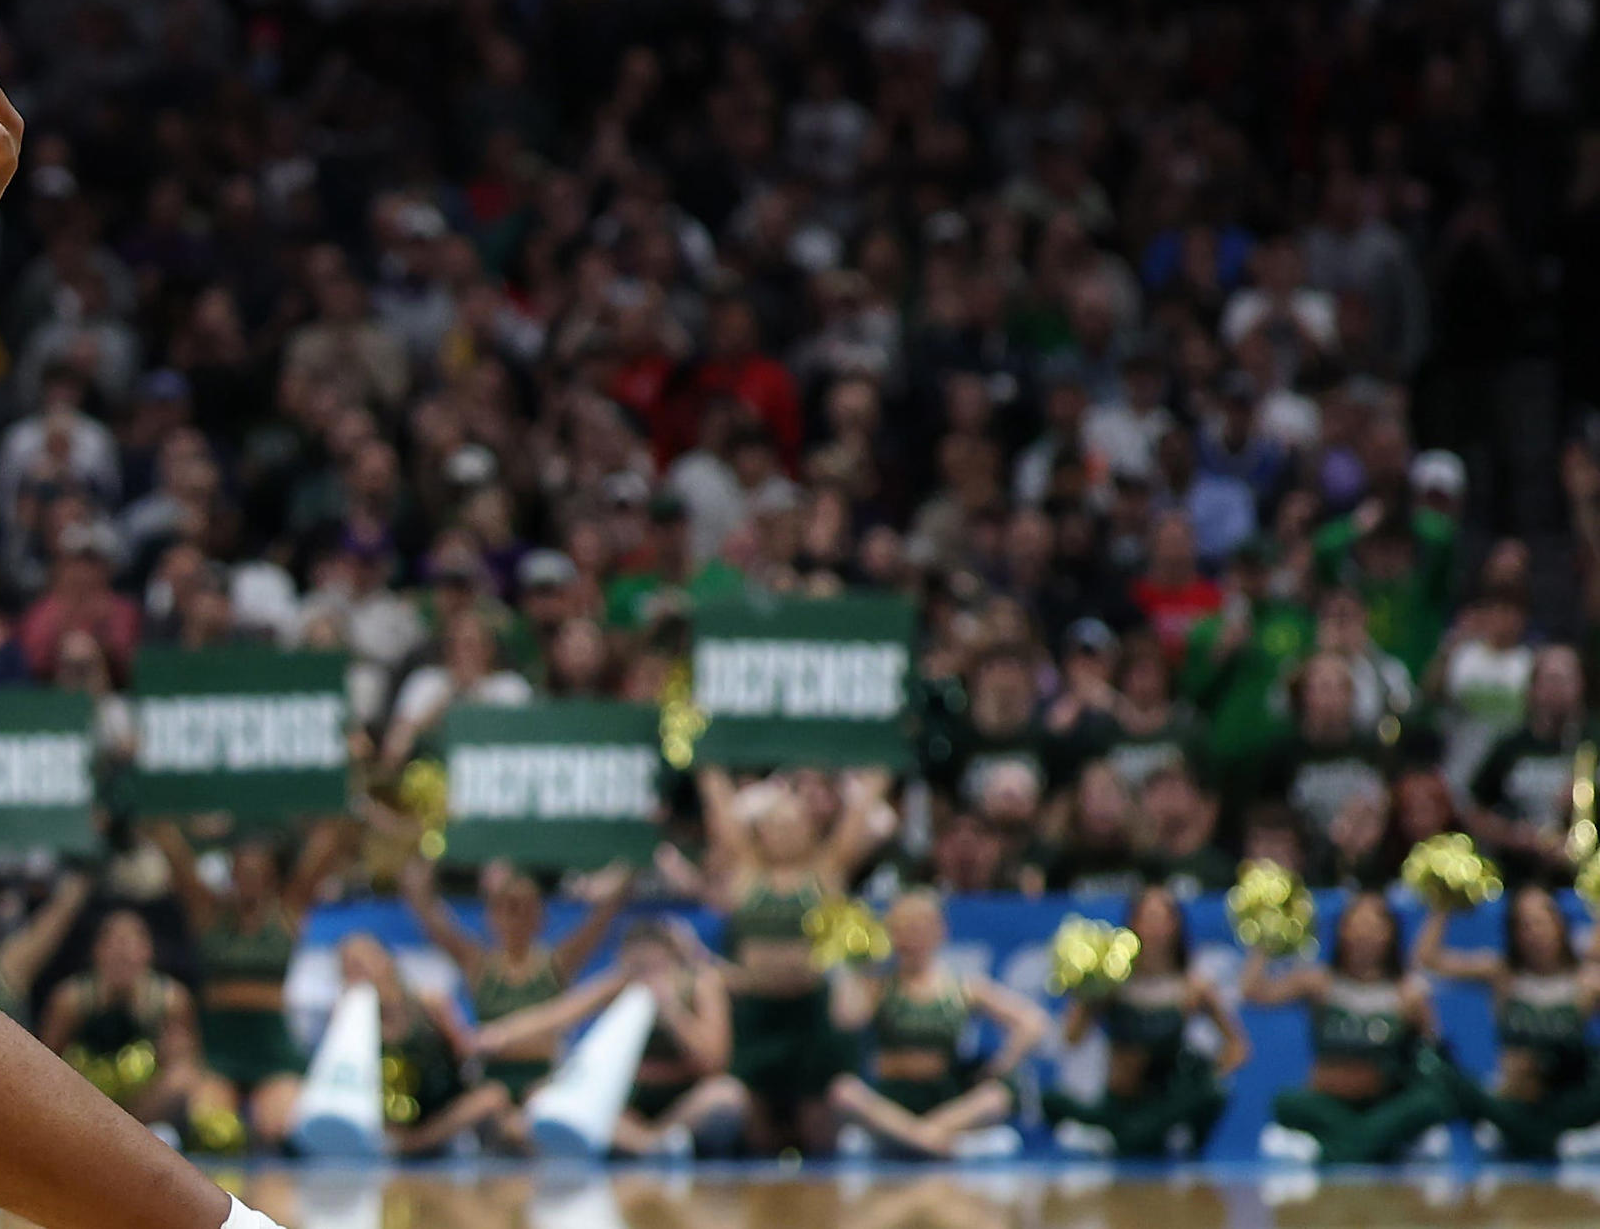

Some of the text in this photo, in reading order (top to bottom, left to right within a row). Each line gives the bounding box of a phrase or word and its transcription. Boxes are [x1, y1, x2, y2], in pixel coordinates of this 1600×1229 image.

[691, 638, 908, 721] DEFENSE
[136, 692, 346, 773] DEFENSE
[448, 743, 661, 819] DEFENSE
